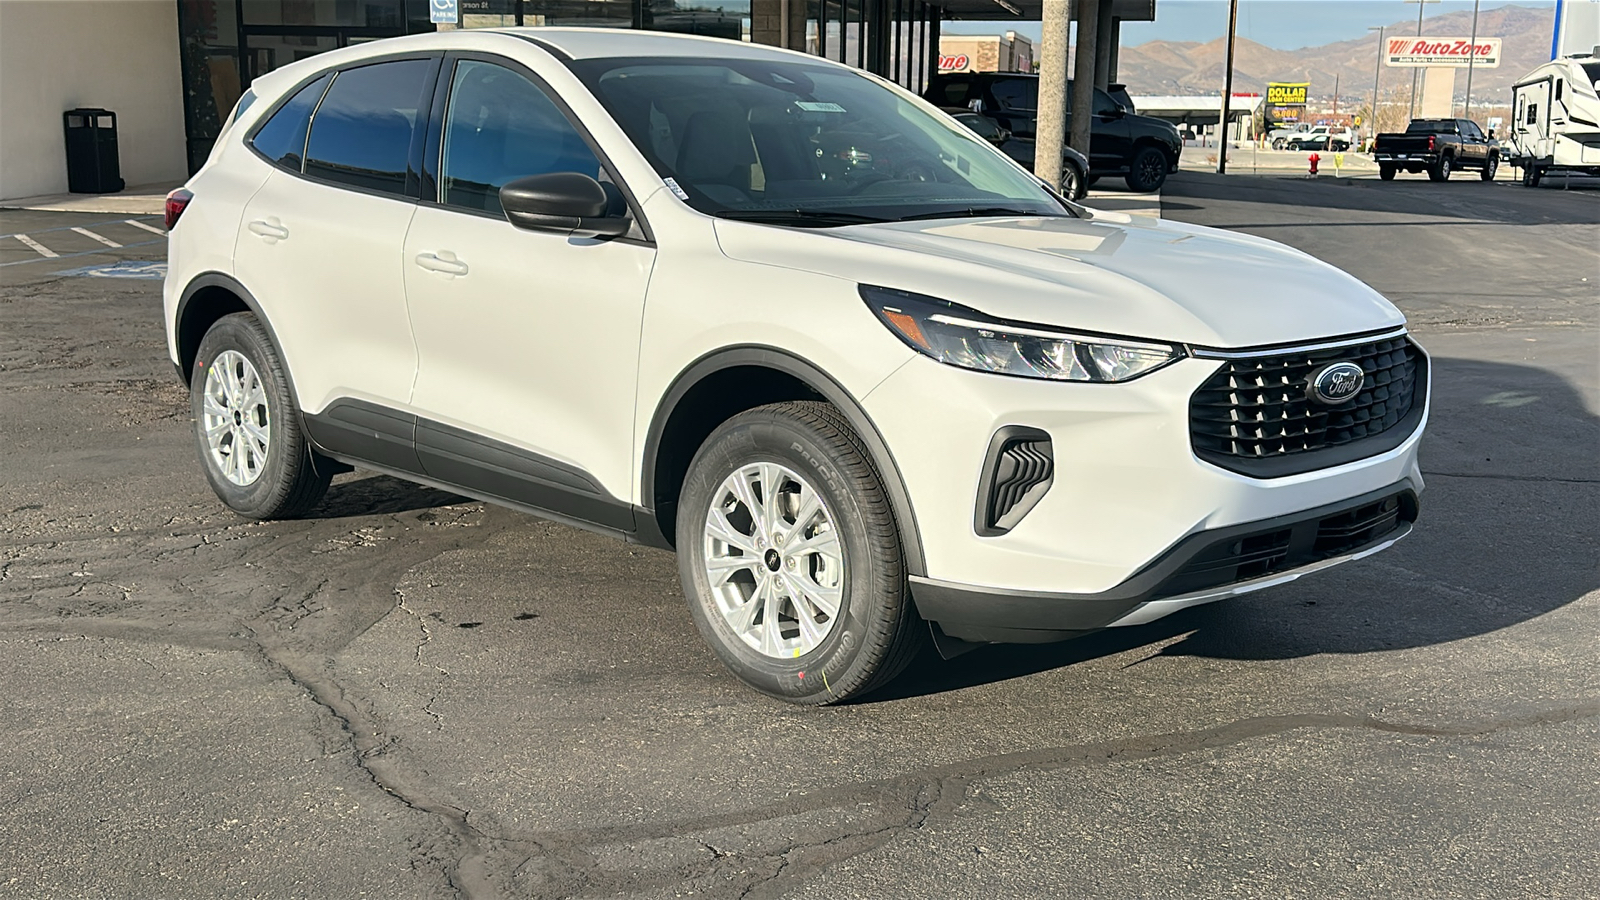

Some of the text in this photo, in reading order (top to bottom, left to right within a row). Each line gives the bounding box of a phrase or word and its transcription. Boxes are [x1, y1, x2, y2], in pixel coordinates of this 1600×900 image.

[1410, 40, 1492, 56] AutoZone
[1268, 87, 1306, 97] DOLLAR
[1328, 371, 1357, 395] Ford
